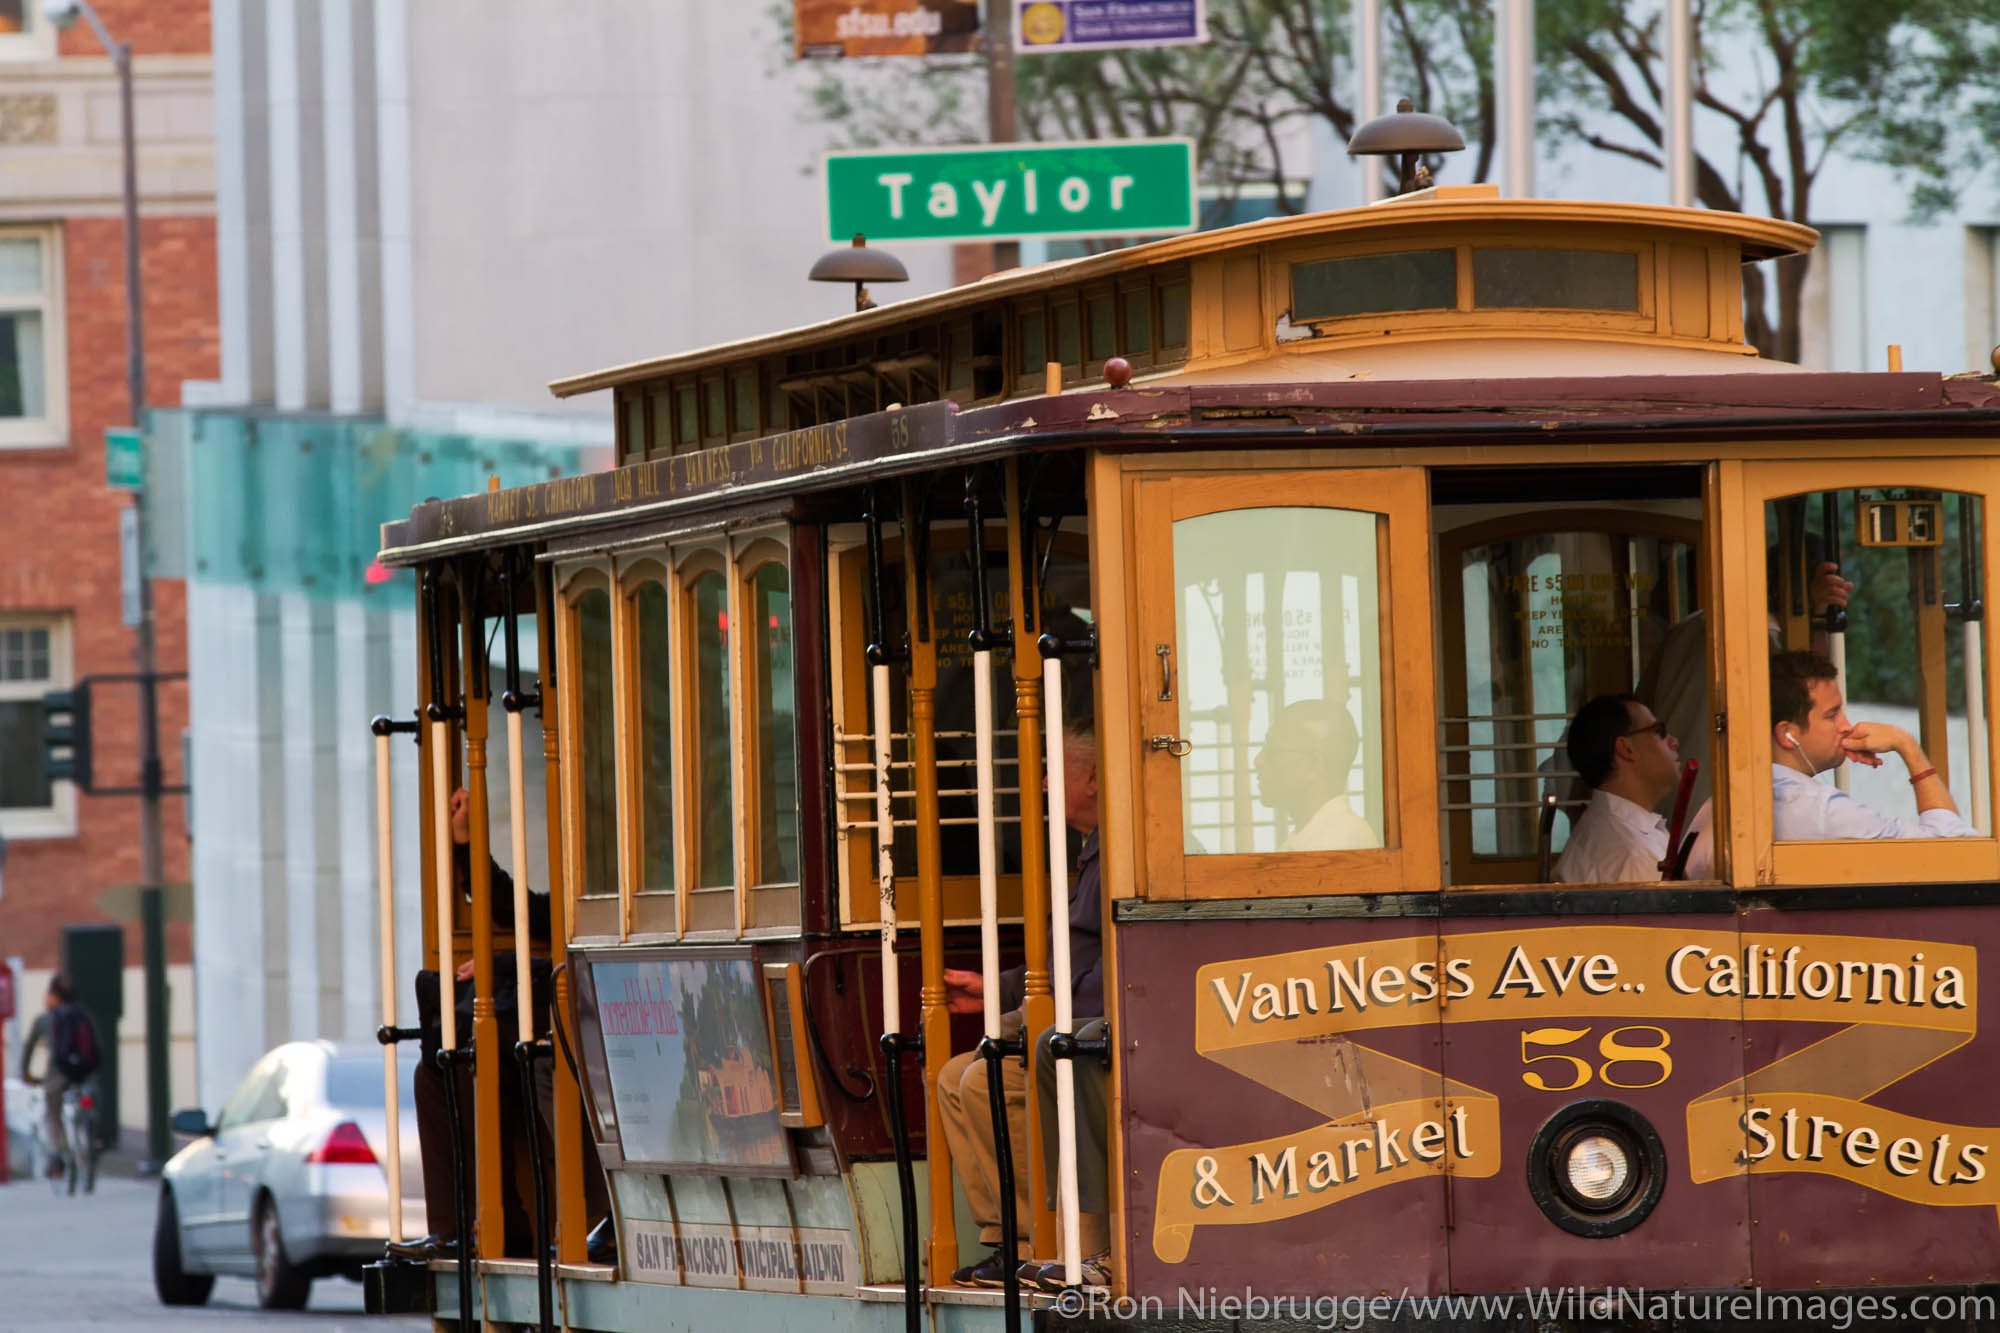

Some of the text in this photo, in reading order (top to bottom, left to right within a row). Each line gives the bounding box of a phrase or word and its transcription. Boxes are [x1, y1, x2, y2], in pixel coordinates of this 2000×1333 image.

[836, 6, 942, 37] sfsu.edu
[878, 170, 1134, 227] Taylor
[544, 476, 595, 515] CHINATOWN
[638, 462, 659, 497] HILL
[772, 428, 833, 471] CALIFORNIA
[1210, 972, 1318, 1027] Van
[1325, 956, 1475, 1013] Ness
[1667, 945, 1967, 1008] California
[1521, 1025, 1672, 1091] 58
[1192, 1106, 1474, 1208] & Market
[1739, 1107, 1989, 1186] Streets
[636, 1233, 660, 1270] SAN
[662, 1235, 727, 1275] FRNCISCO
[793, 1242, 845, 1282] AILWAY
